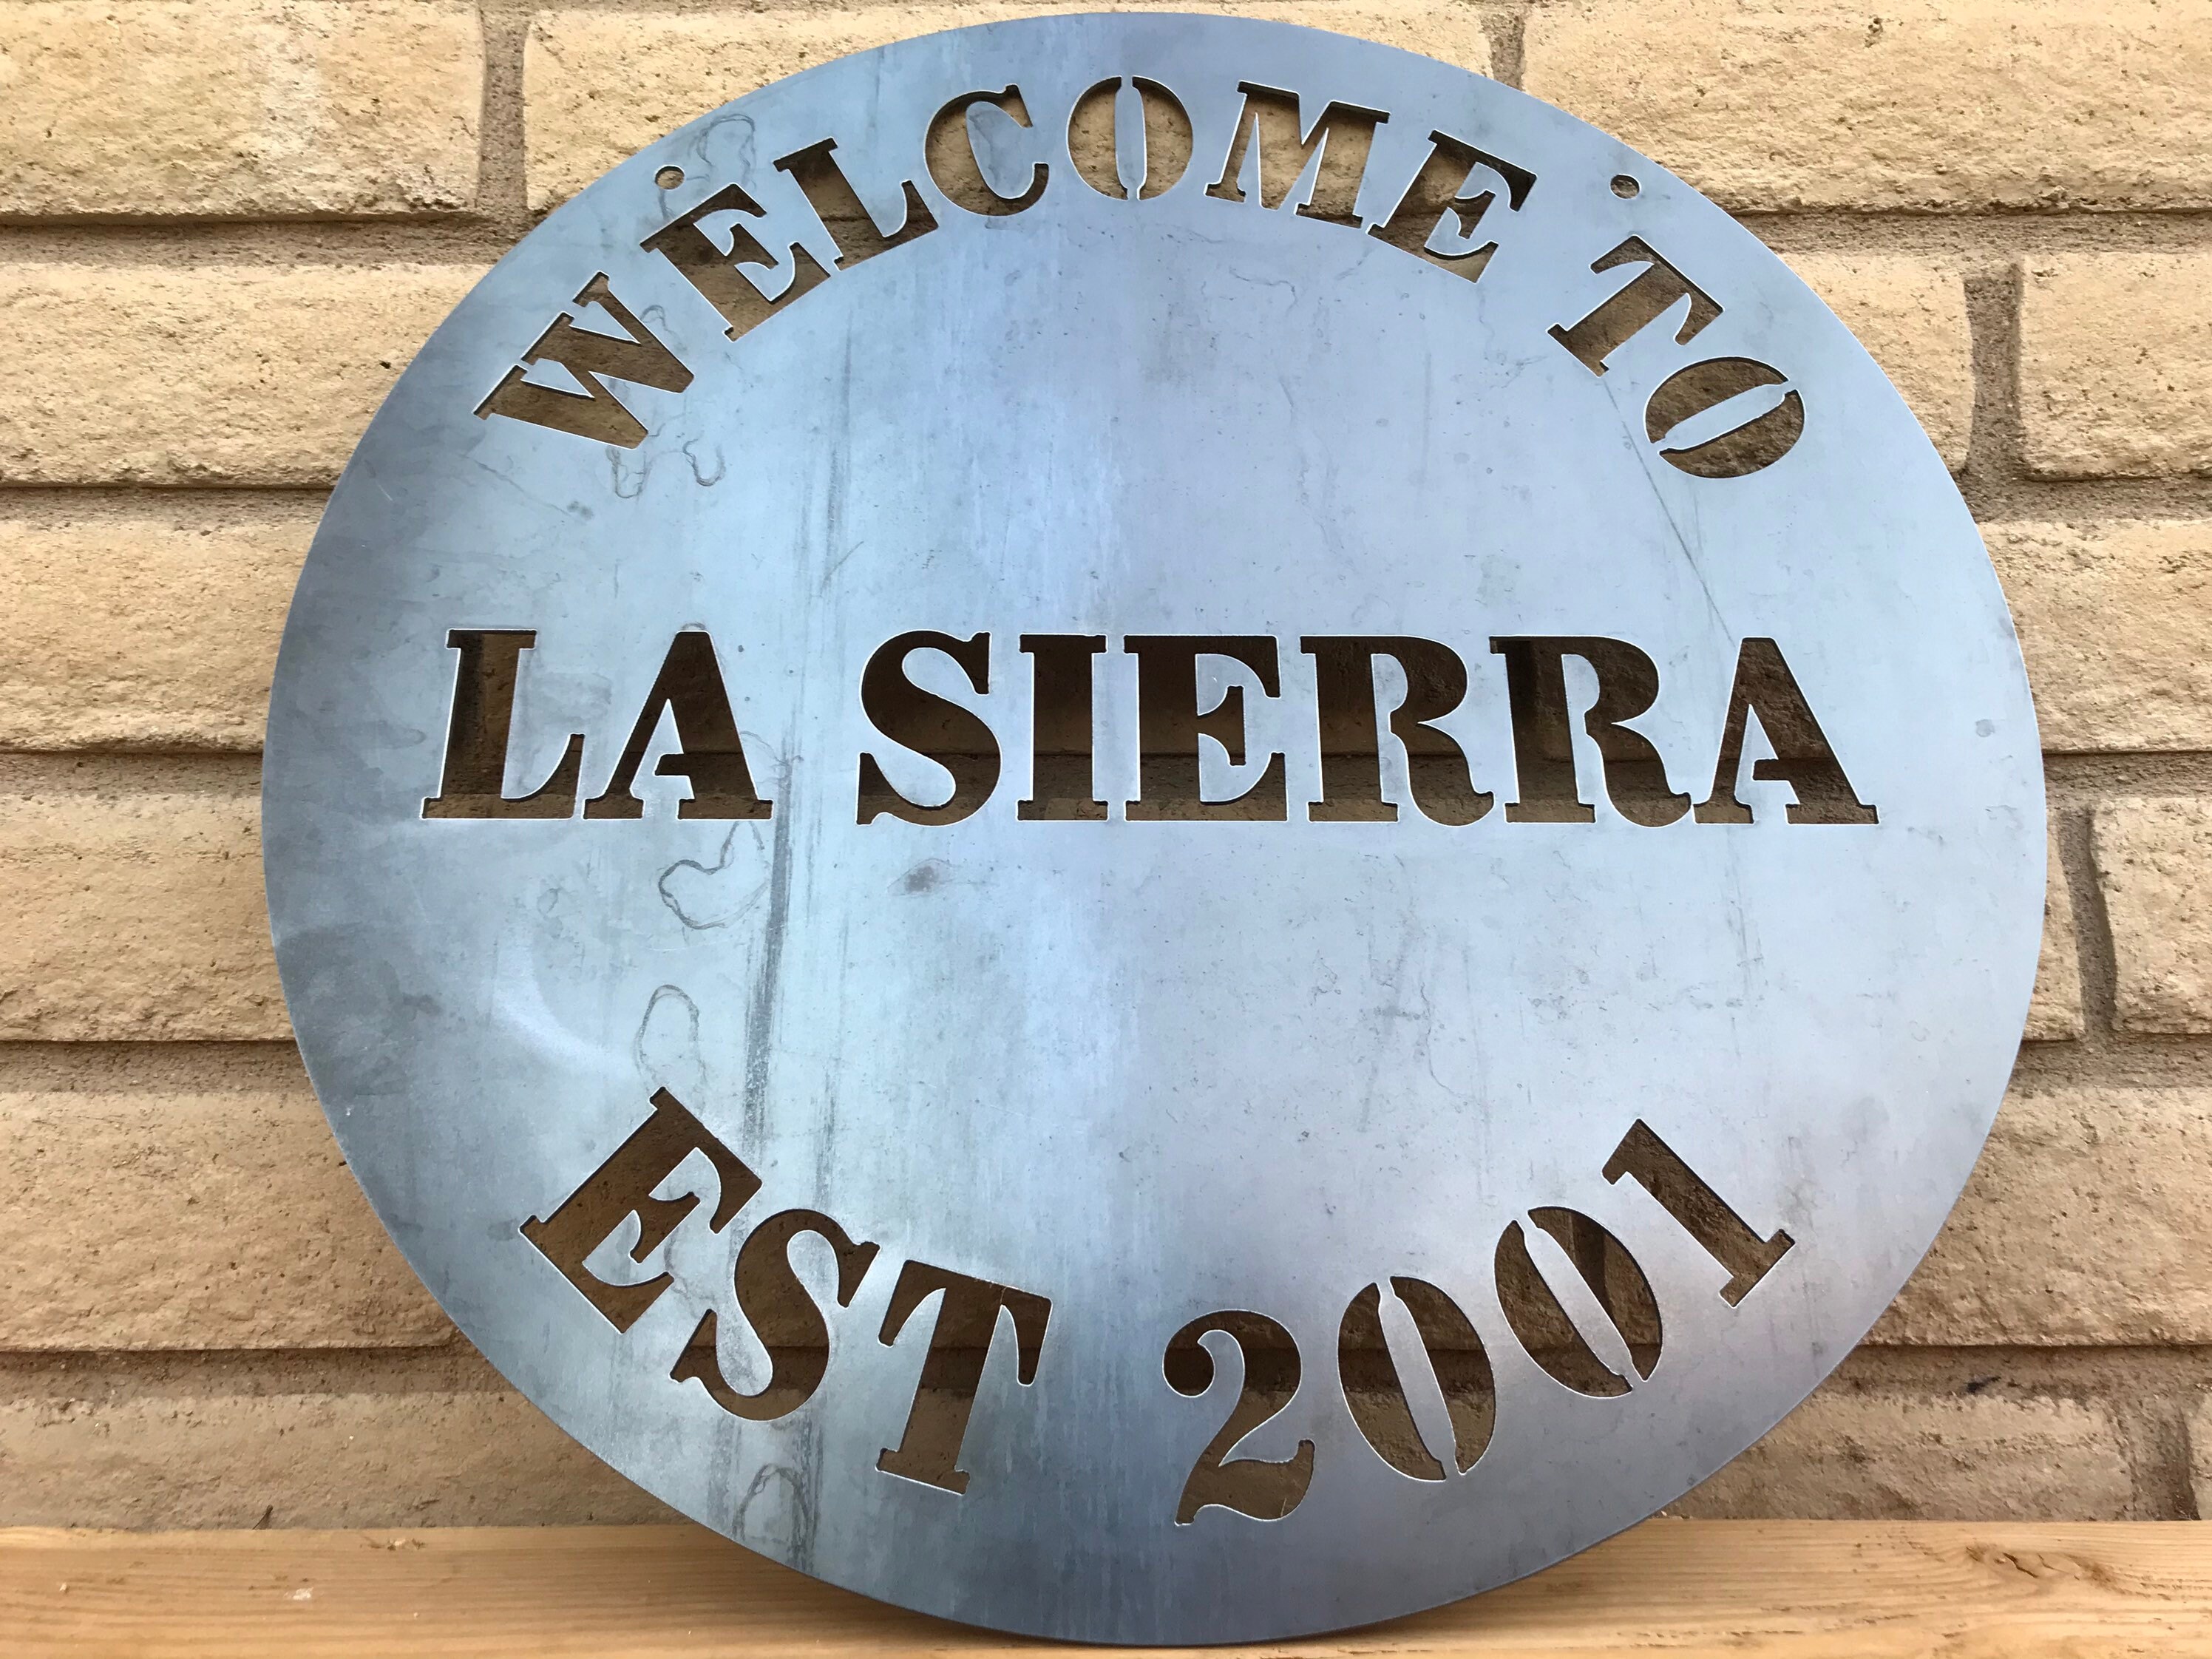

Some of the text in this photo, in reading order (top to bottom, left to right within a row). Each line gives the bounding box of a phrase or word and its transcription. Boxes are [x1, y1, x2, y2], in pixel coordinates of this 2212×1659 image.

[474, 76, 1805, 479] WELCOME TO
[421, 629, 1879, 826] LA SIERRA
[520, 1087, 1794, 1525] EST 2001
